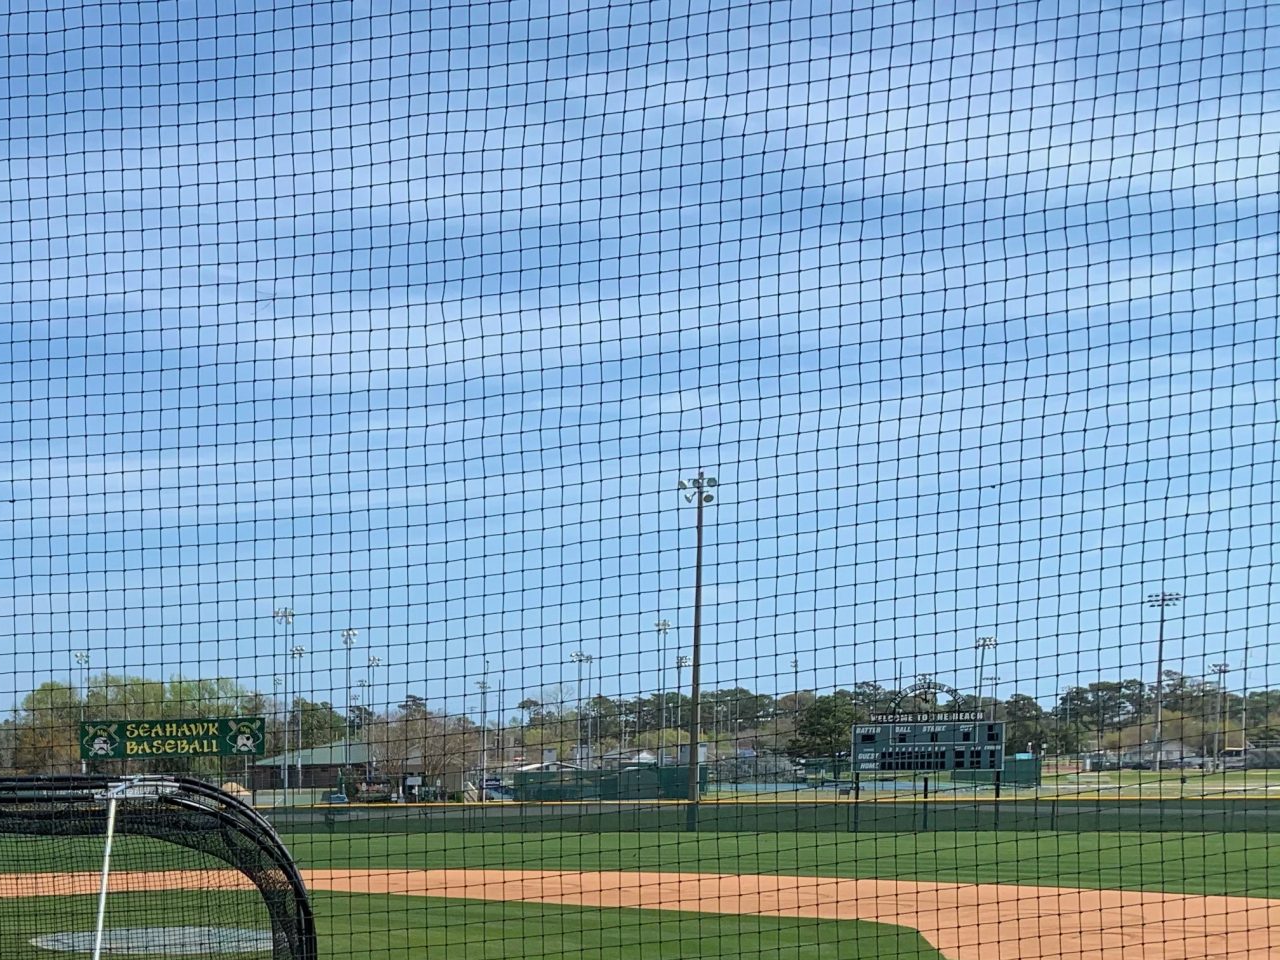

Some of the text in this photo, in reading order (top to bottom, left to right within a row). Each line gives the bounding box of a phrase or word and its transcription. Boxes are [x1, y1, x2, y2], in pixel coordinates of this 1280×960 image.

[870, 714, 913, 722] WELCOME
[952, 712, 983, 720] BEACH
[126, 722, 219, 738] SEAHAWK
[922, 725, 946, 733] STRIKE
[126, 739, 219, 755] BASEBALL
[858, 752, 880, 760] GUEST
